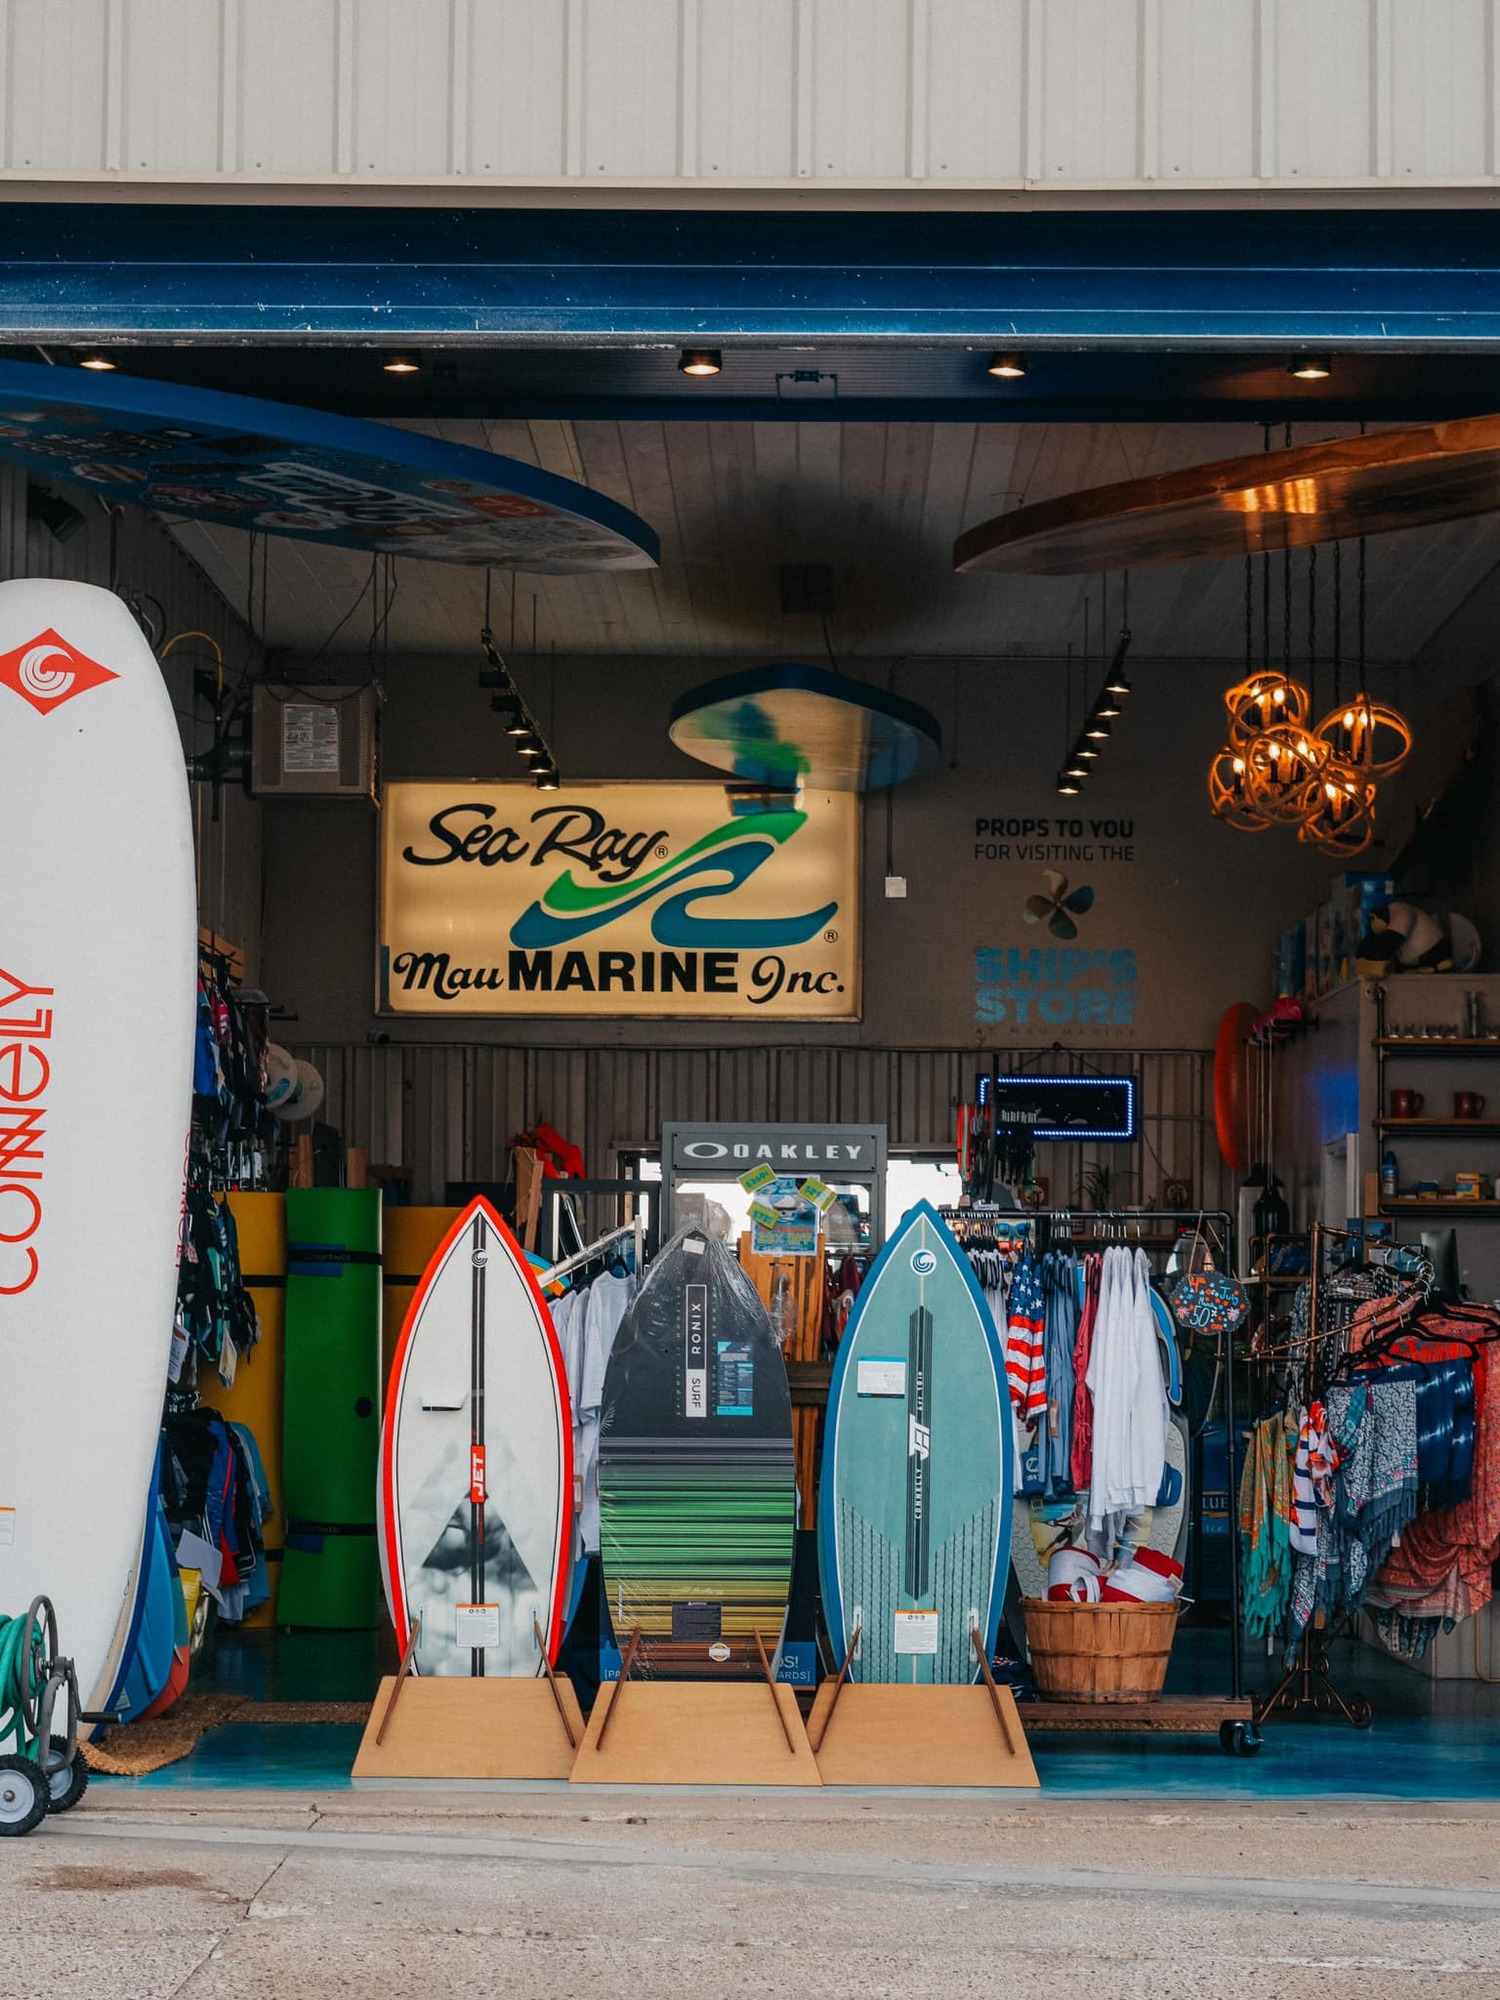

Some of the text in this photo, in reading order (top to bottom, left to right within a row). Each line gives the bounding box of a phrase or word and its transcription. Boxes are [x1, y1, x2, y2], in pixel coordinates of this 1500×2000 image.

[402, 803, 530, 866] Sea
[975, 818, 1134, 839] PROPS TO YOU
[974, 844, 1134, 861] FOR VISITING THE
[393, 950, 846, 1005] Mau MARINE Inc.
[973, 947, 1138, 985] SHIP'S
[973, 987, 1138, 1025] STORE
[733, 1143, 862, 1160] OAKLEY
[787, 1231, 812, 1244] OFF
[691, 1303, 702, 1355] RONIX
[691, 1377, 702, 1409] SURF
[908, 1413, 930, 1461] JET
[472, 1452, 484, 1497] JET
[914, 1468, 922, 1520] CONNELLY
[1202, 1496, 1228, 1509] LUE
